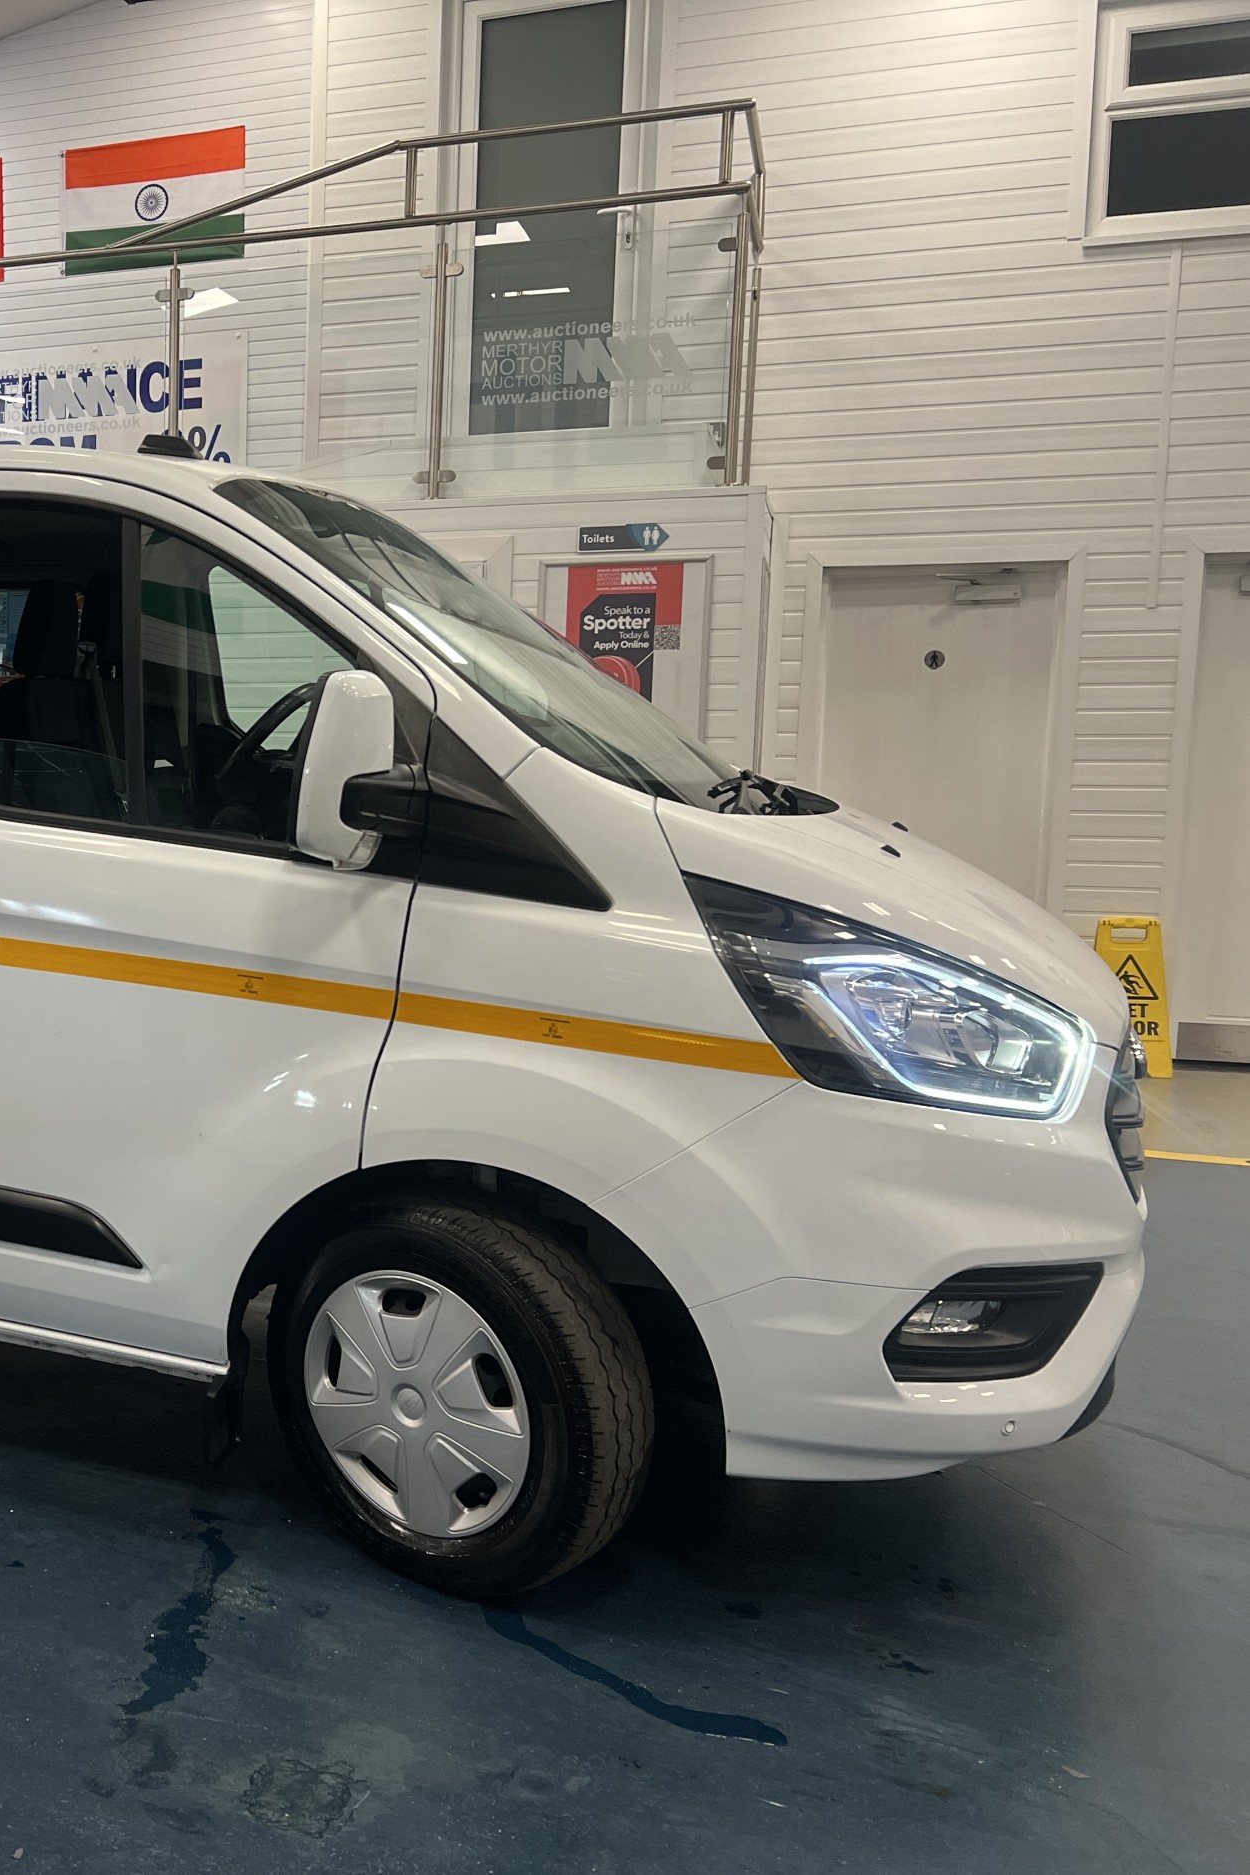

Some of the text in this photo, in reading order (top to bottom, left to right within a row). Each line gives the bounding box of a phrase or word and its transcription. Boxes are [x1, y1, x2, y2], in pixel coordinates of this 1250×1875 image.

[482, 341, 562, 359] MERTHYR
[481, 356, 563, 377] MOTOR
[481, 373, 563, 390] AUCTIONS
[581, 534, 615, 544] Toilets
[604, 605, 633, 617] Speak
[633, 606, 644, 615] to
[582, 614, 651, 634] Spotter
[619, 631, 650, 641] Today &
[593, 640, 650, 651] Apply Online
